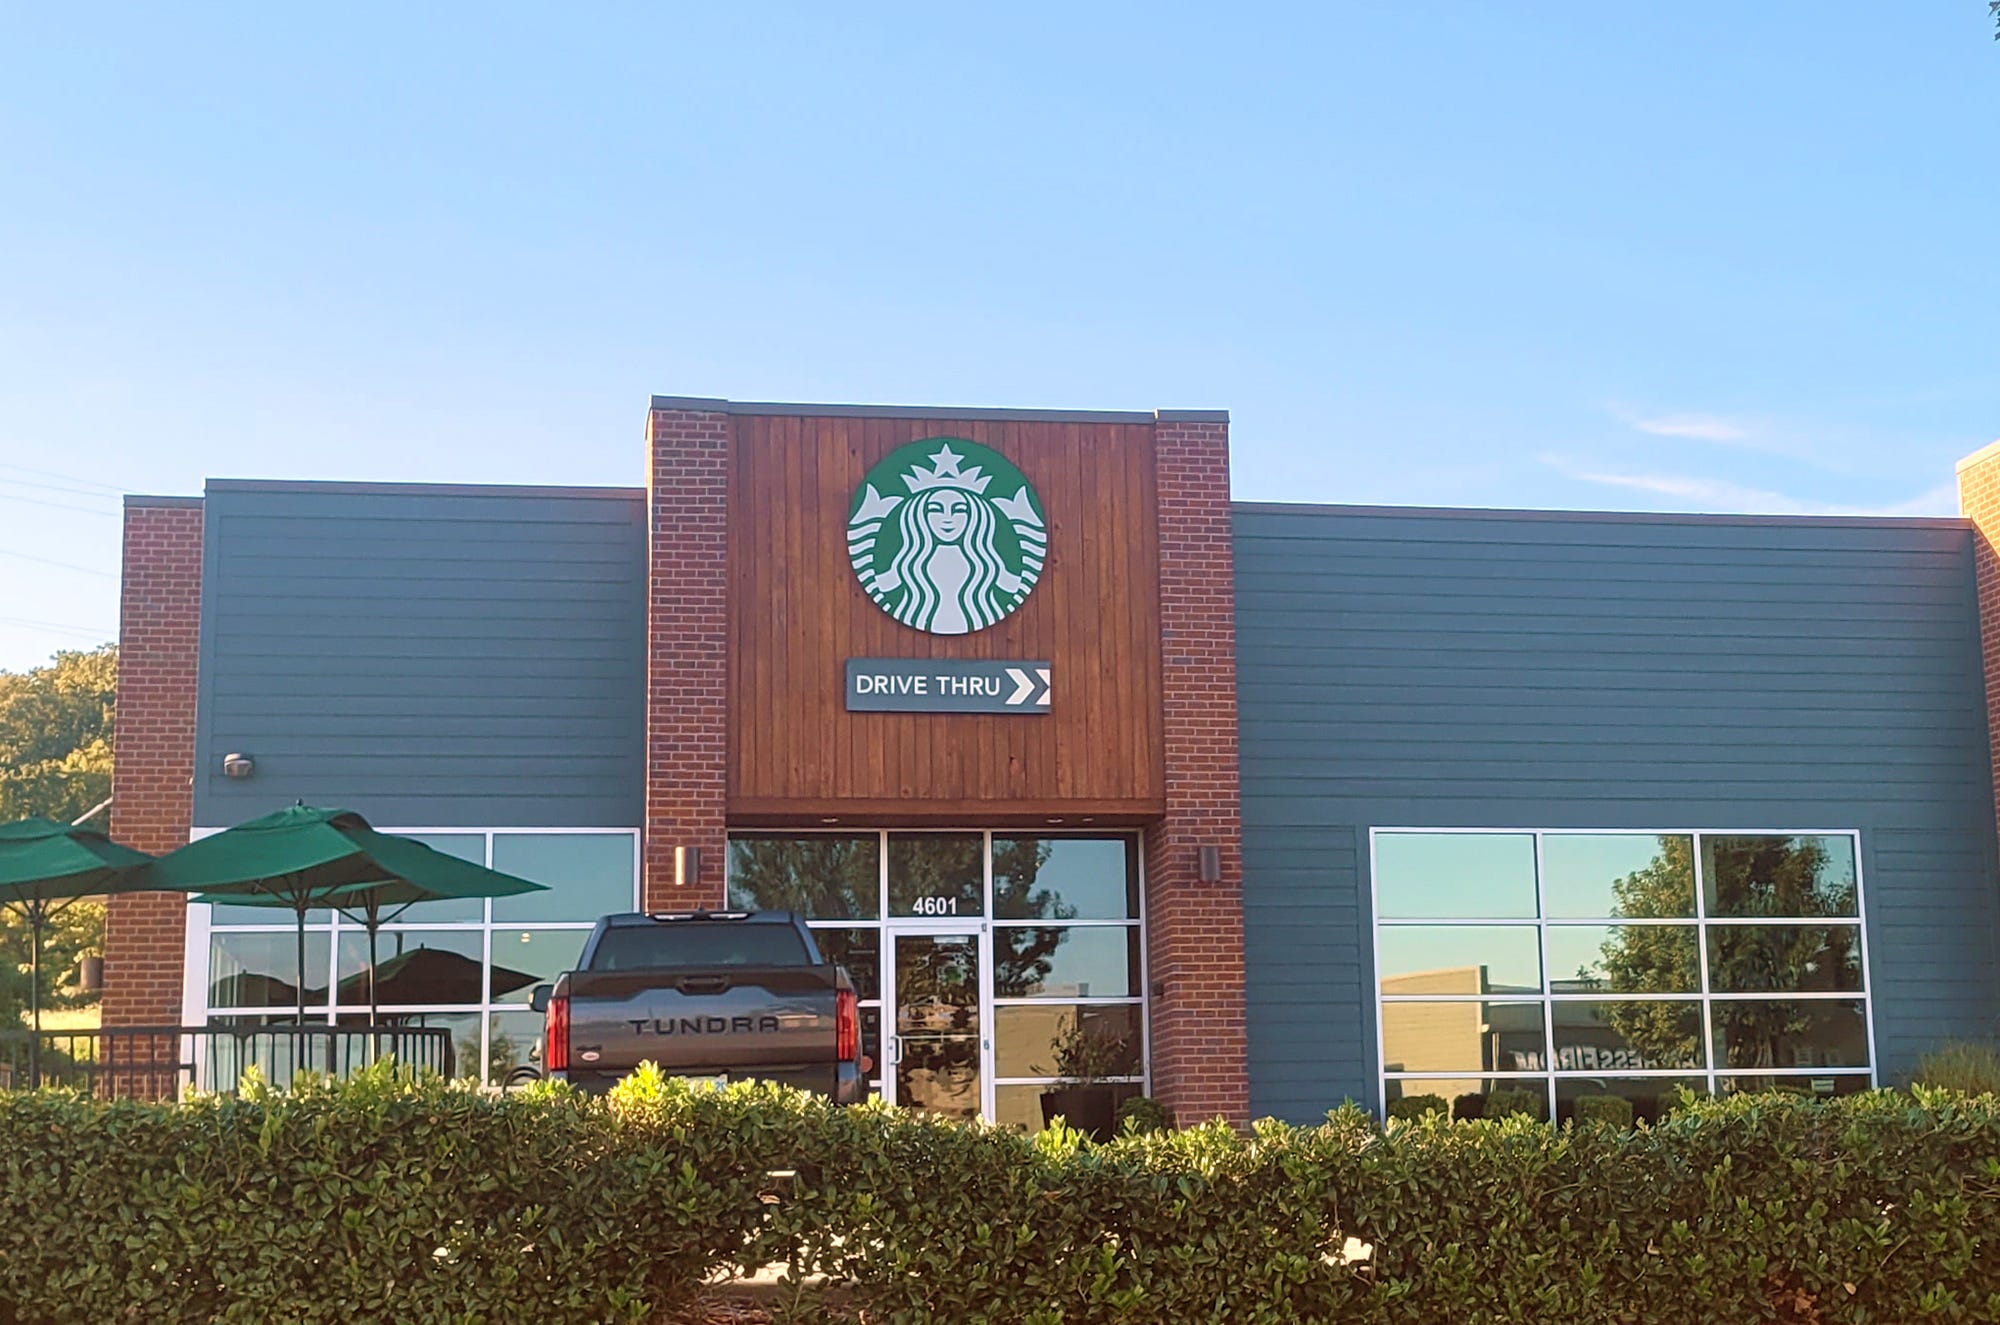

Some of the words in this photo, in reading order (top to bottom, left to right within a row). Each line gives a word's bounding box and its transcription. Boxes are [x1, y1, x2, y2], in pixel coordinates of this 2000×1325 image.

[856, 674, 928, 695] DRIVE
[936, 676, 1000, 696] THRU
[912, 896, 956, 915] 4601
[627, 1016, 780, 1035] TUNDRA
